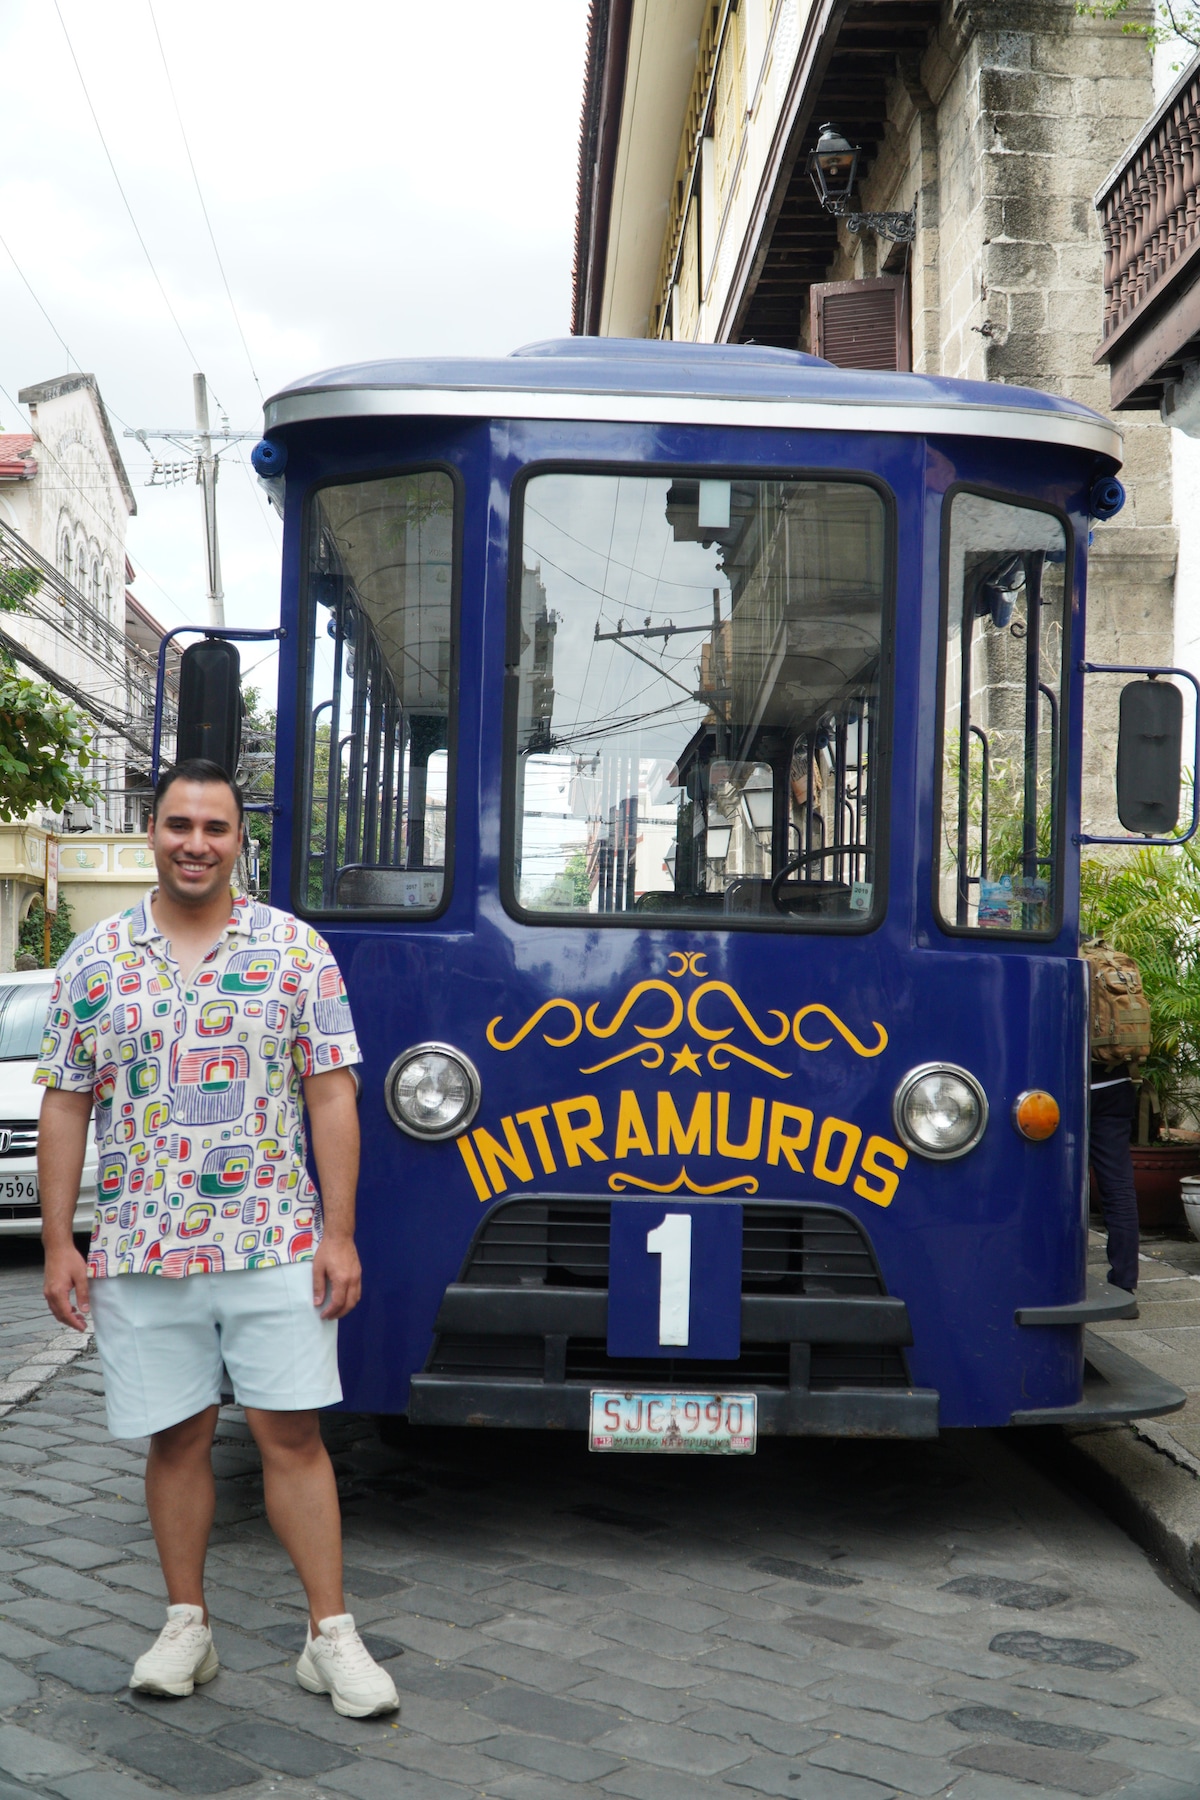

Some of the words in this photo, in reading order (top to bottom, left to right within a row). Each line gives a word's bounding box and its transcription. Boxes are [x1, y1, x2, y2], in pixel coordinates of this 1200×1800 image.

[456, 1090, 909, 1208] INTRAMUROS
[647, 1213, 692, 1346] 1
[603, 1400, 664, 1433] SJC
[684, 1401, 743, 1434] 990
